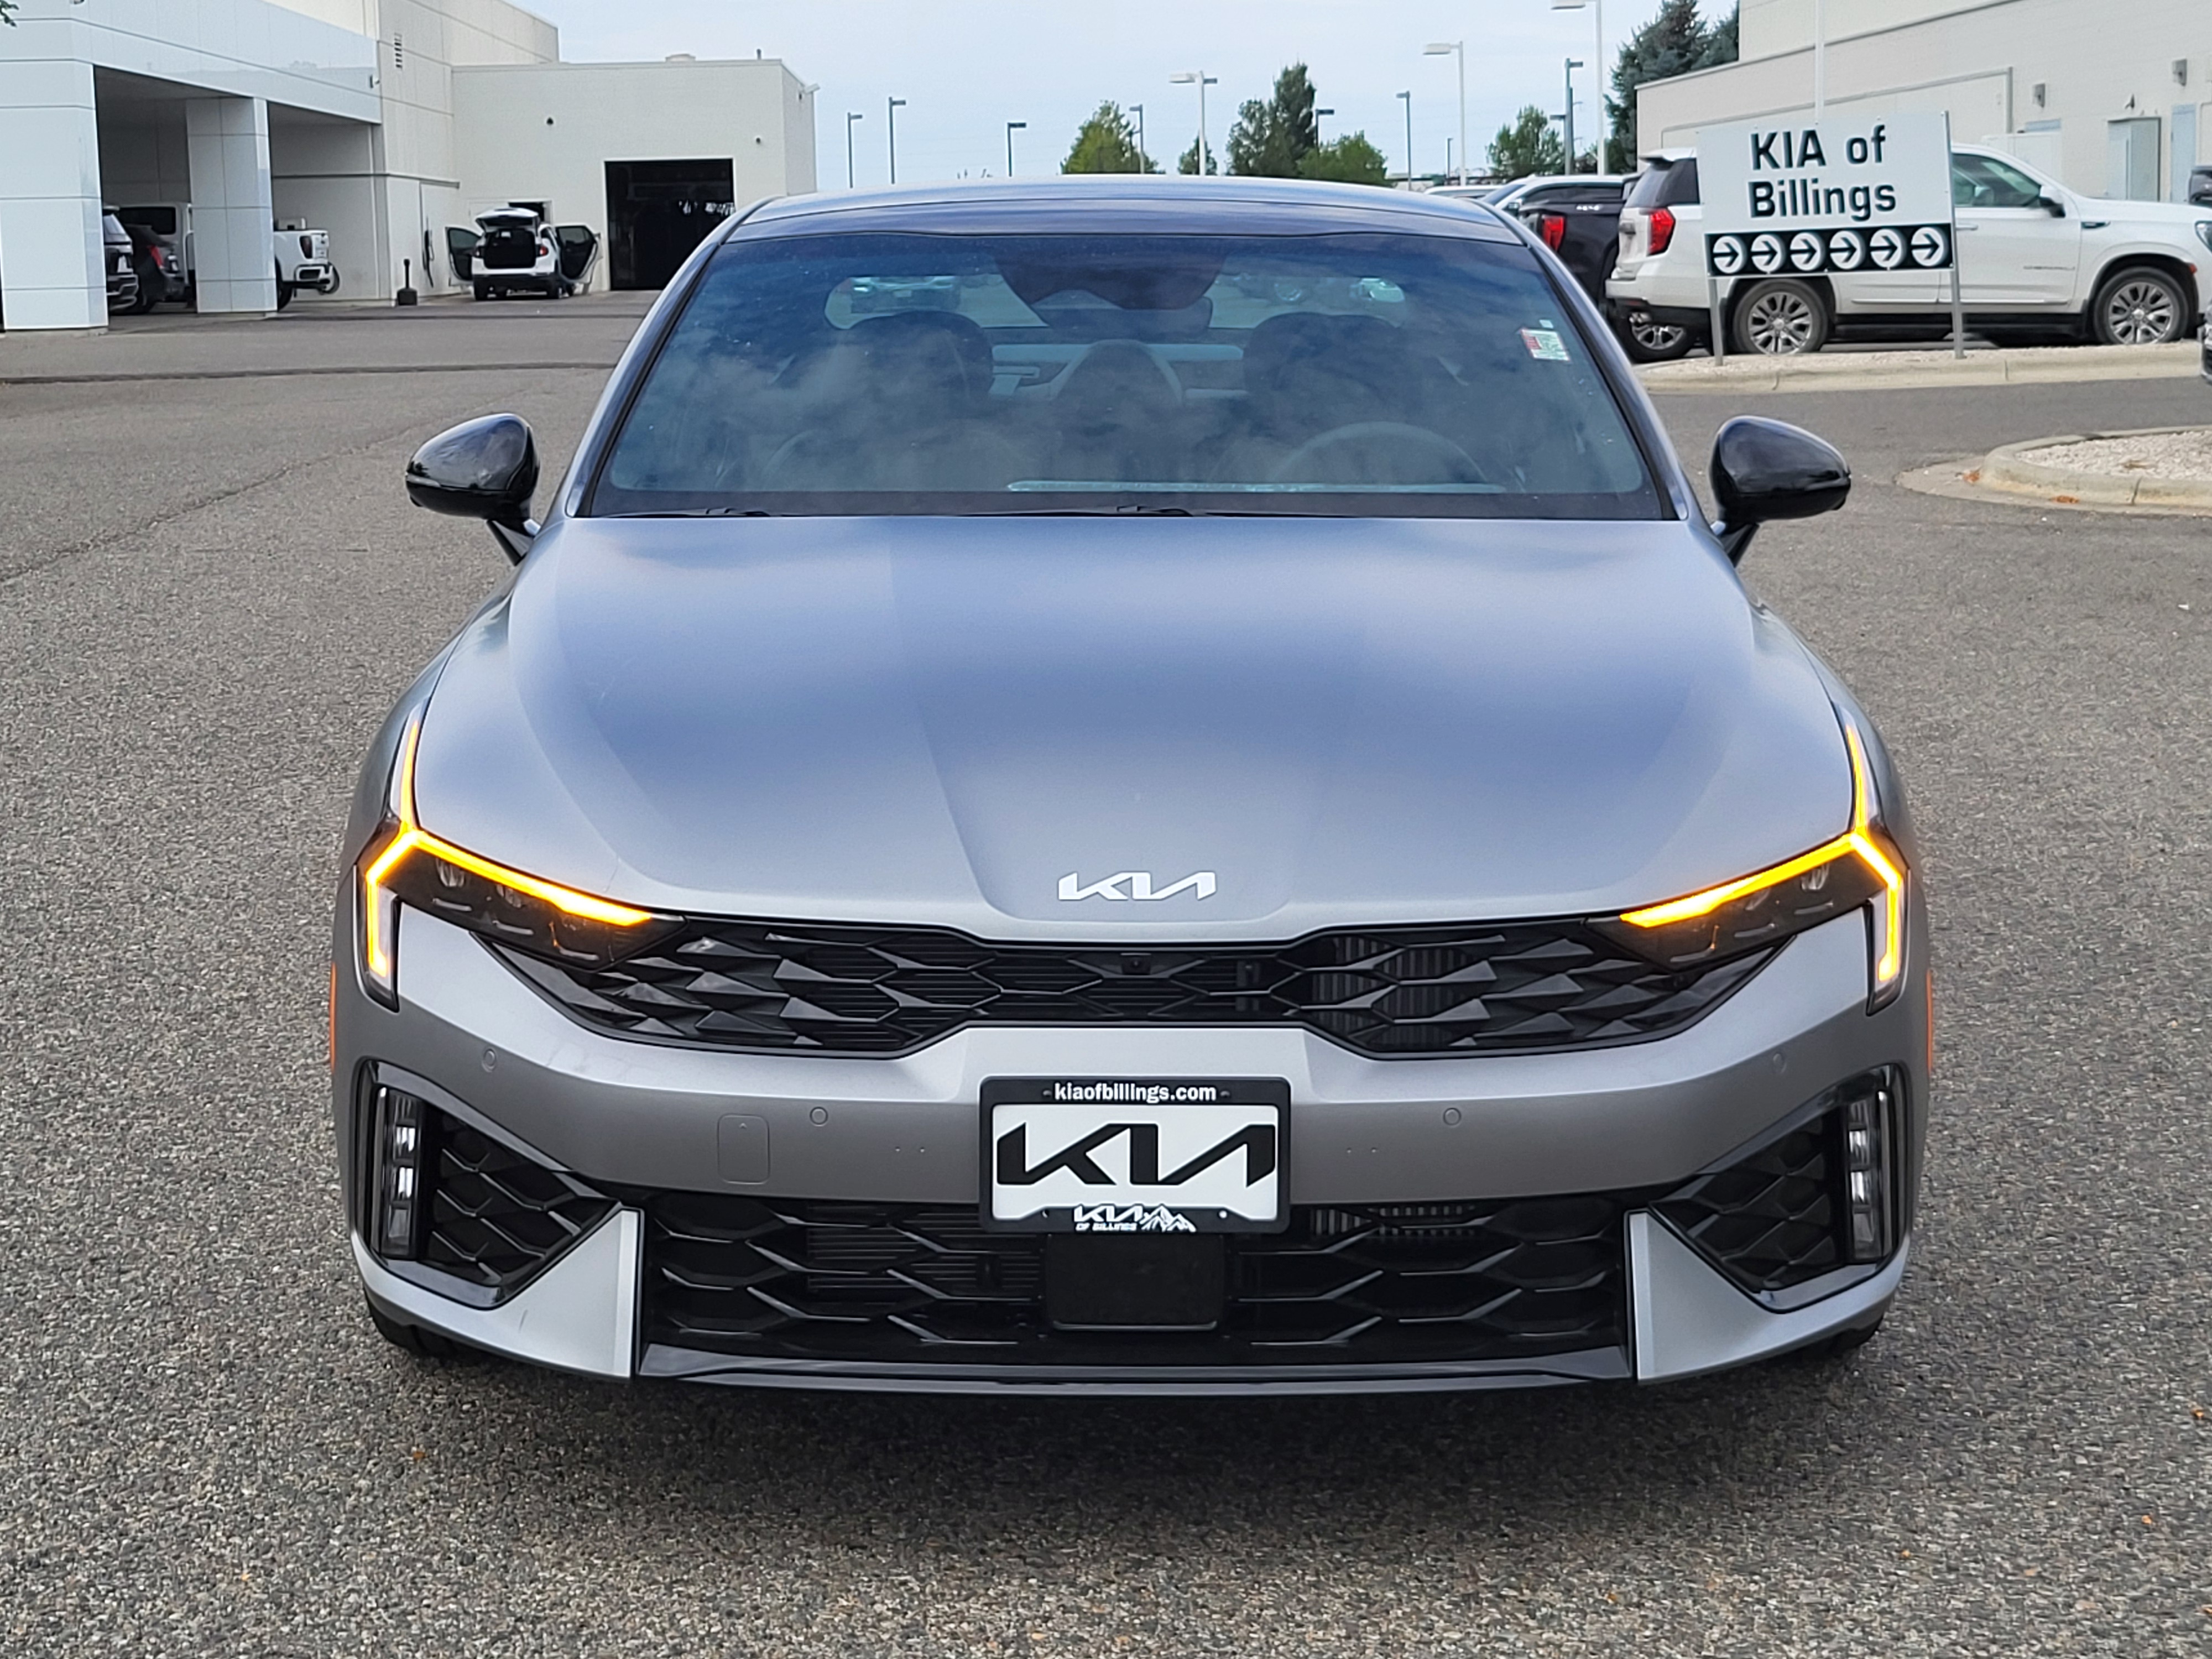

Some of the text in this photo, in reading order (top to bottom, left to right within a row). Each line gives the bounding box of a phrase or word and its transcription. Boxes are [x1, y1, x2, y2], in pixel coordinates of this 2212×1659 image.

[1751, 124, 1886, 170] KIA of
[1748, 178, 1896, 221] Billings
[1058, 872, 1216, 901] KIA
[1054, 1082, 1217, 1103] kiaofbillings.com
[997, 1121, 1276, 1188] KIA
[1074, 1205, 1144, 1223] KIA
